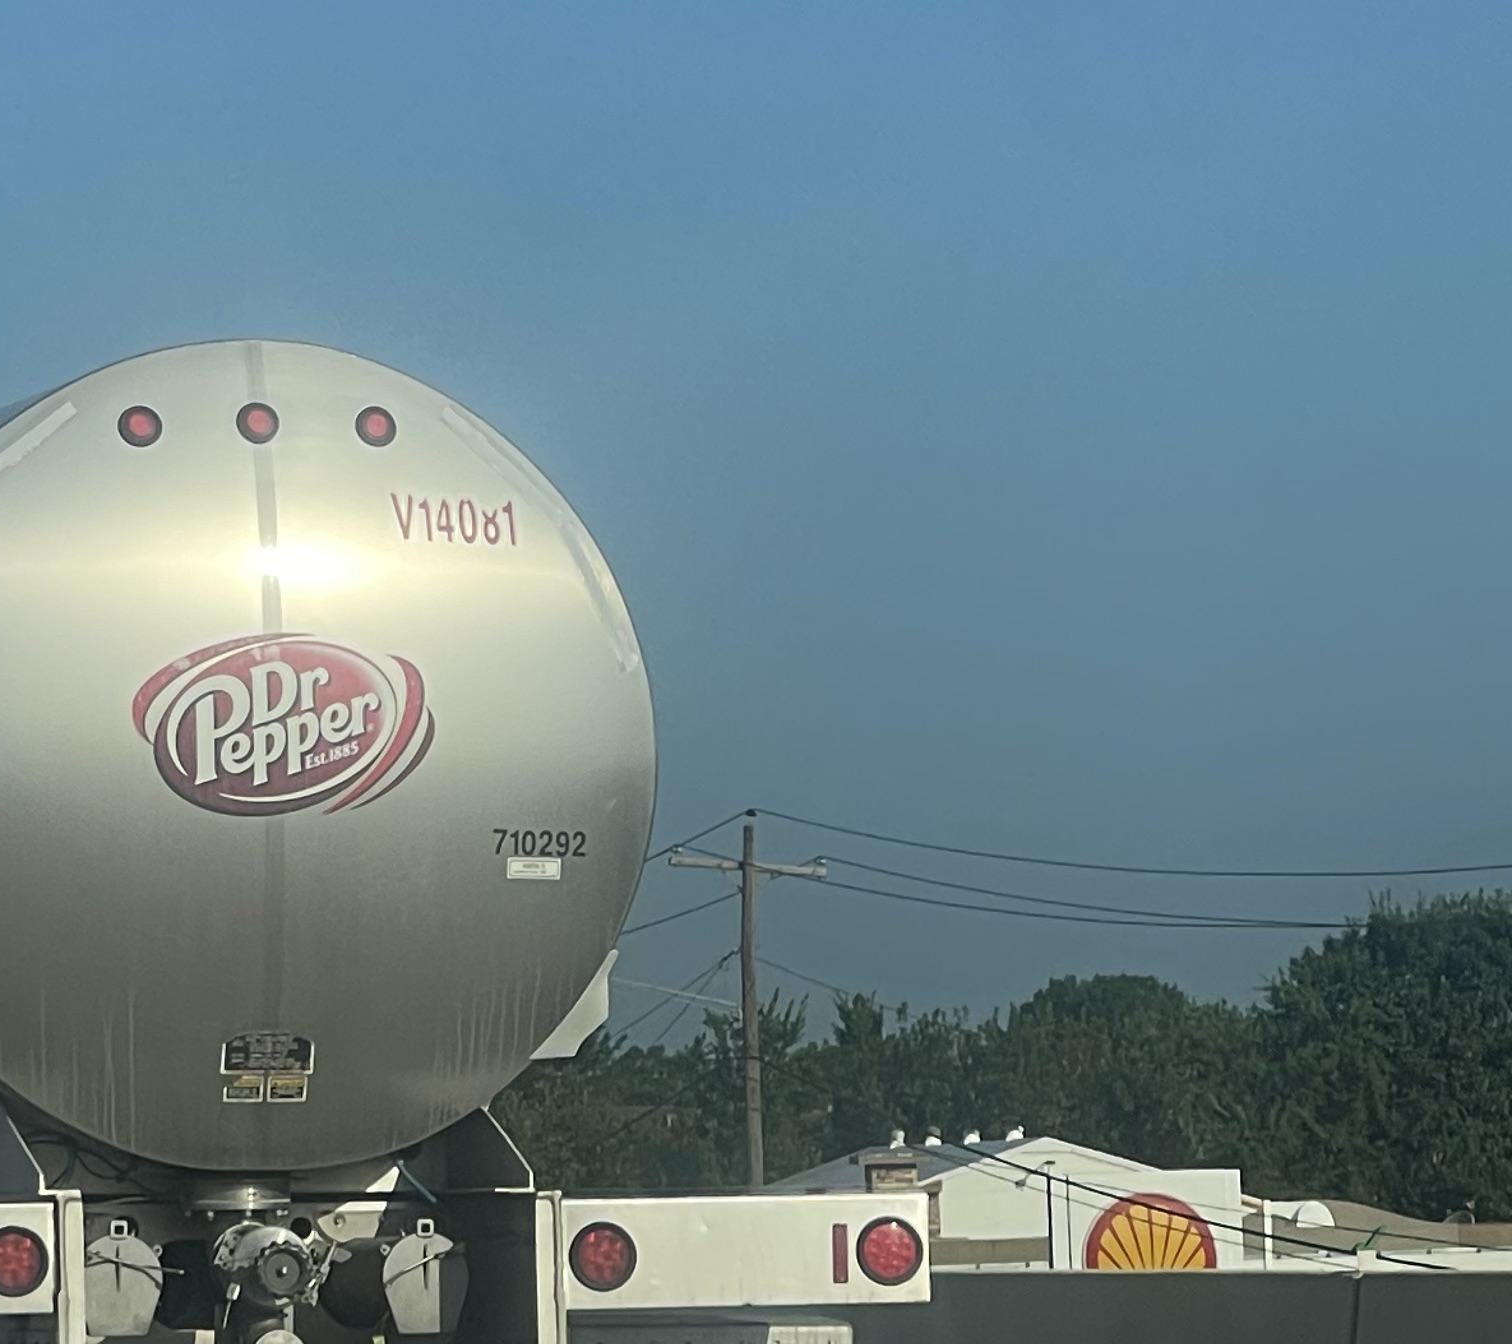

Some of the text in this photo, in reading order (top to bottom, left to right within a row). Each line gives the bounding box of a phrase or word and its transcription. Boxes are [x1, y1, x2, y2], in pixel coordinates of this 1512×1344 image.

[250, 660, 330, 726] Dr
[167, 674, 380, 787] Pepper
[493, 828, 587, 857] 710292
